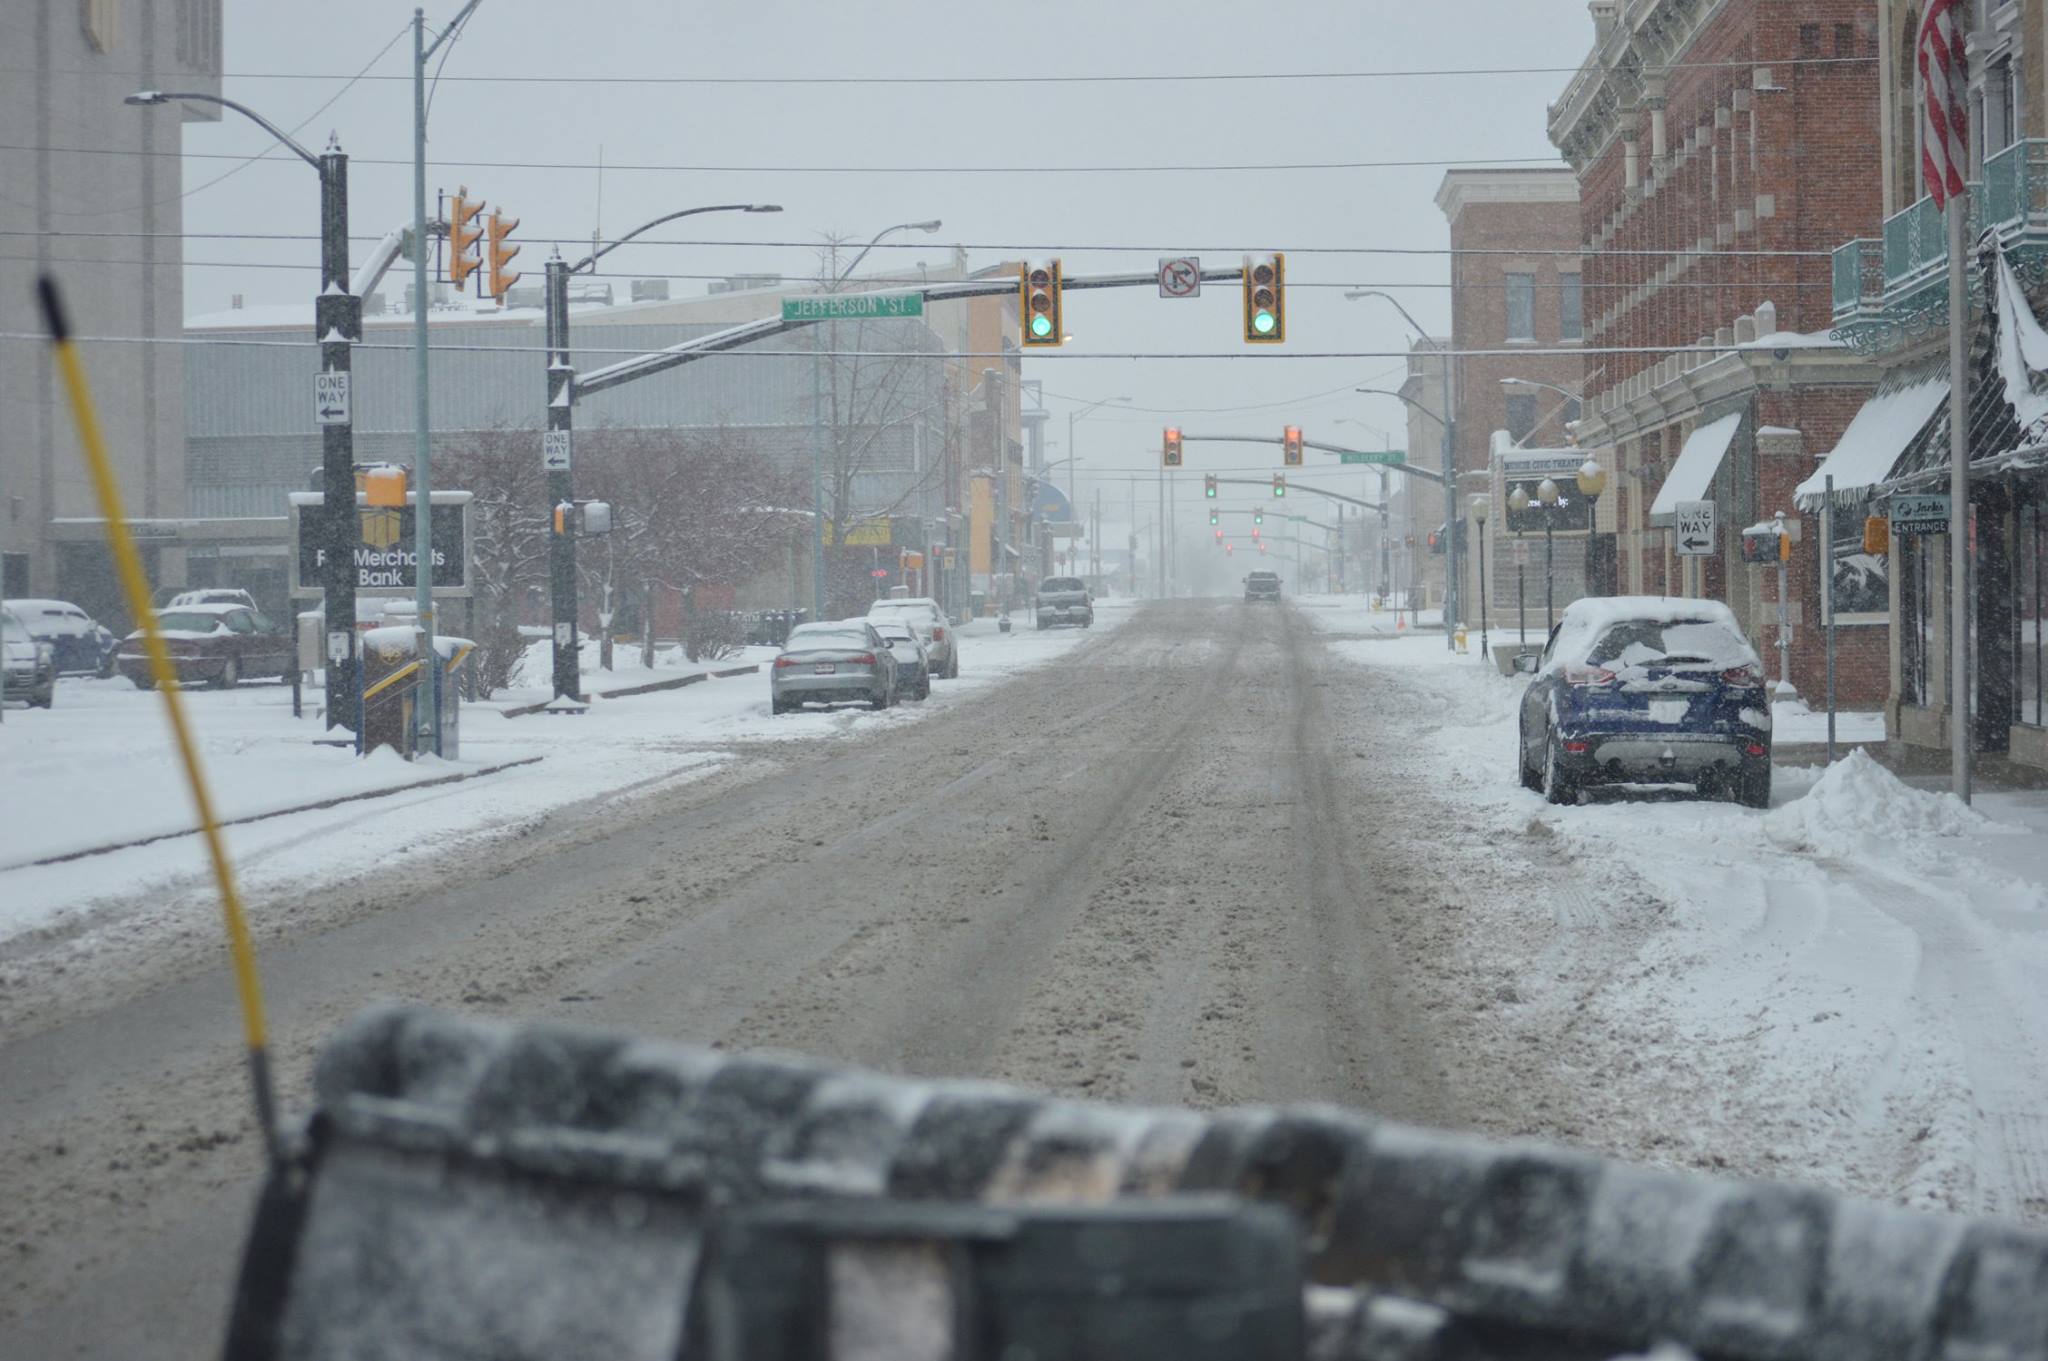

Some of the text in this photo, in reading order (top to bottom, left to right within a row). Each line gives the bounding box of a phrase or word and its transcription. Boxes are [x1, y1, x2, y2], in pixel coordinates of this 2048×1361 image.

[795, 296, 912, 315] JEFFERSON ST.
[318, 376, 346, 389] ONE
[318, 391, 346, 403] WAY
[546, 433, 567, 444] ONE
[546, 445, 568, 455] WAY
[1680, 521, 1711, 533] WAY
[1895, 521, 1945, 533] ENTRANCE
[354, 549, 445, 566] Merchats
[359, 568, 404, 586] Bank
